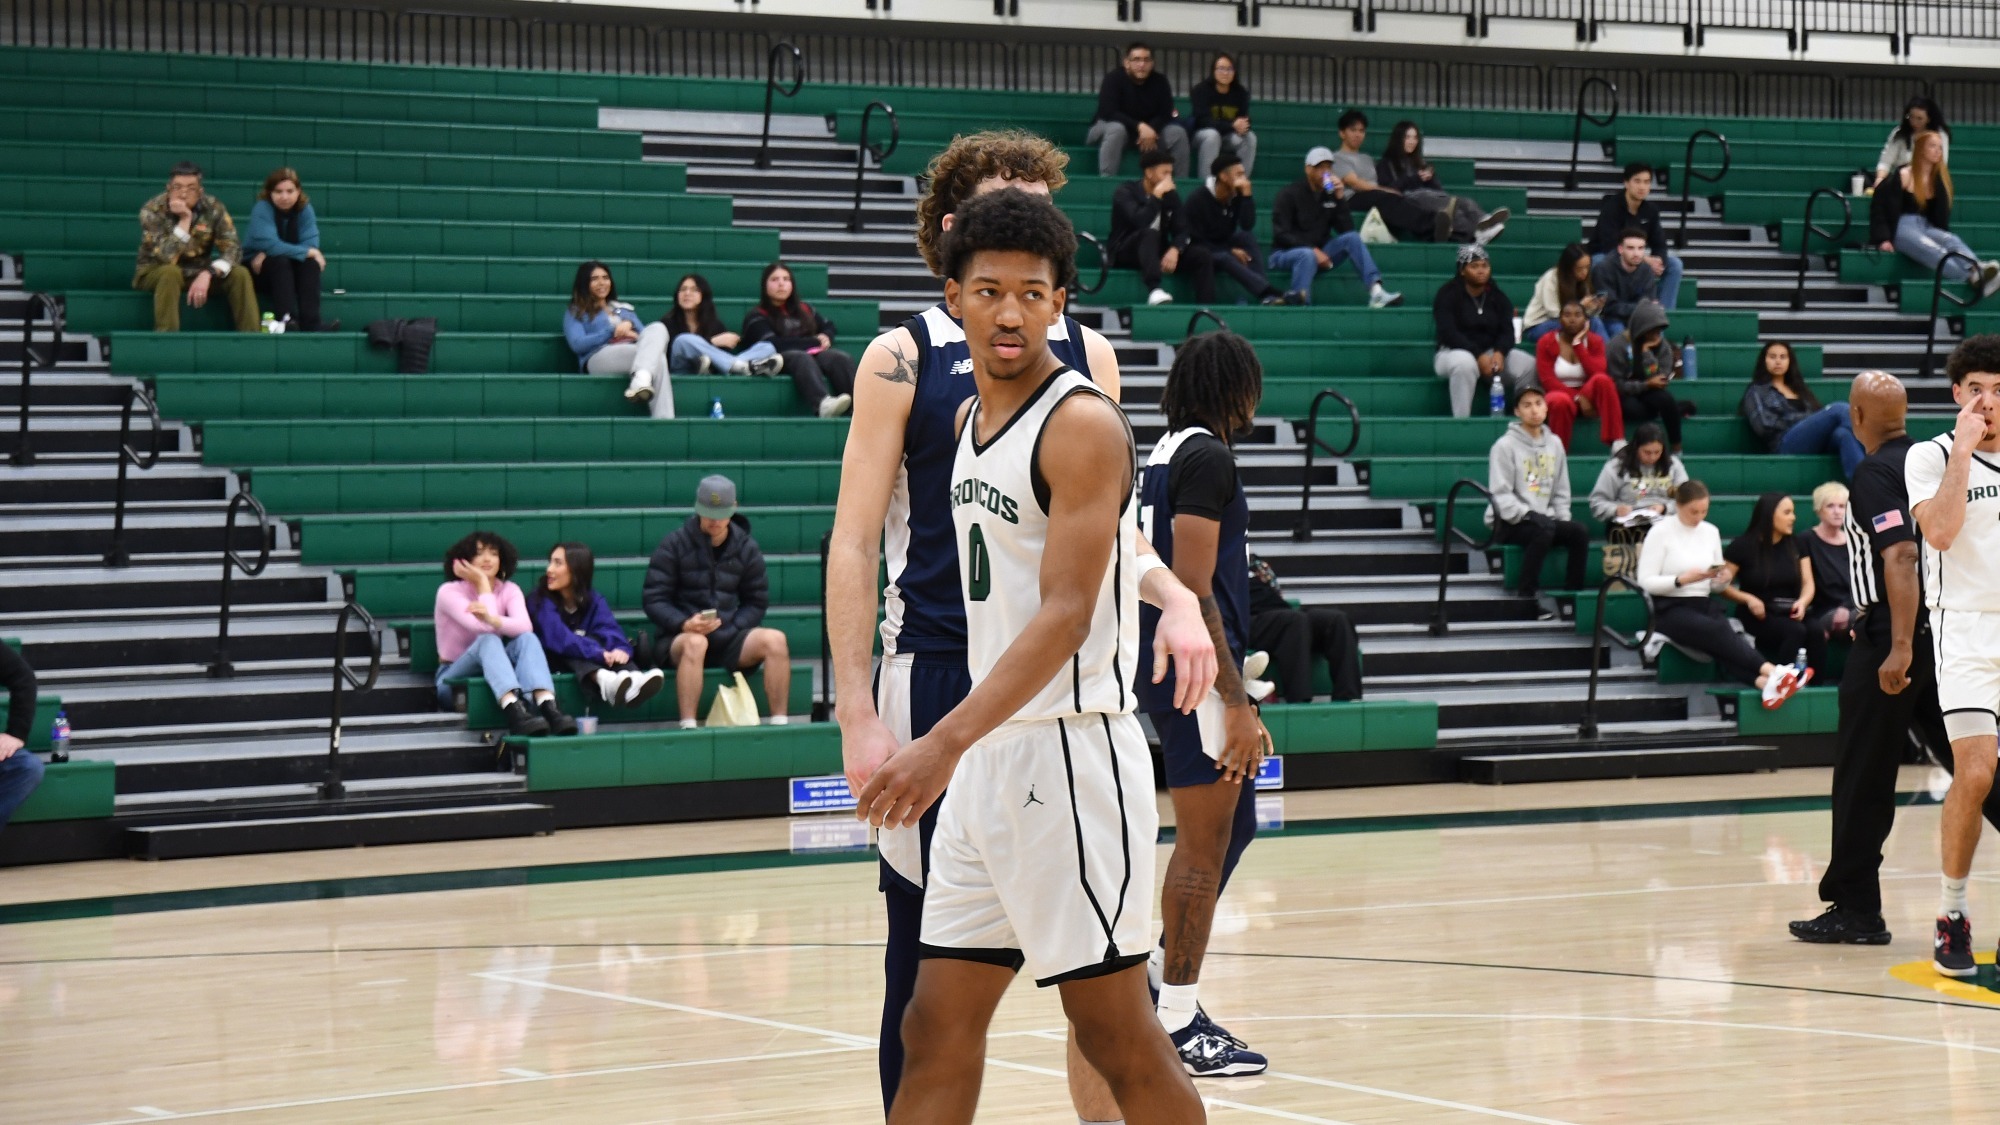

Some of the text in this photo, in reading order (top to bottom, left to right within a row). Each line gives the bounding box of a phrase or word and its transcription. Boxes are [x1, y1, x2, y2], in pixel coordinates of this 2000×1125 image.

[950, 478, 1018, 525] RONCOS
[1966, 484, 2000, 503] BRO
[969, 523, 990, 601] 0
